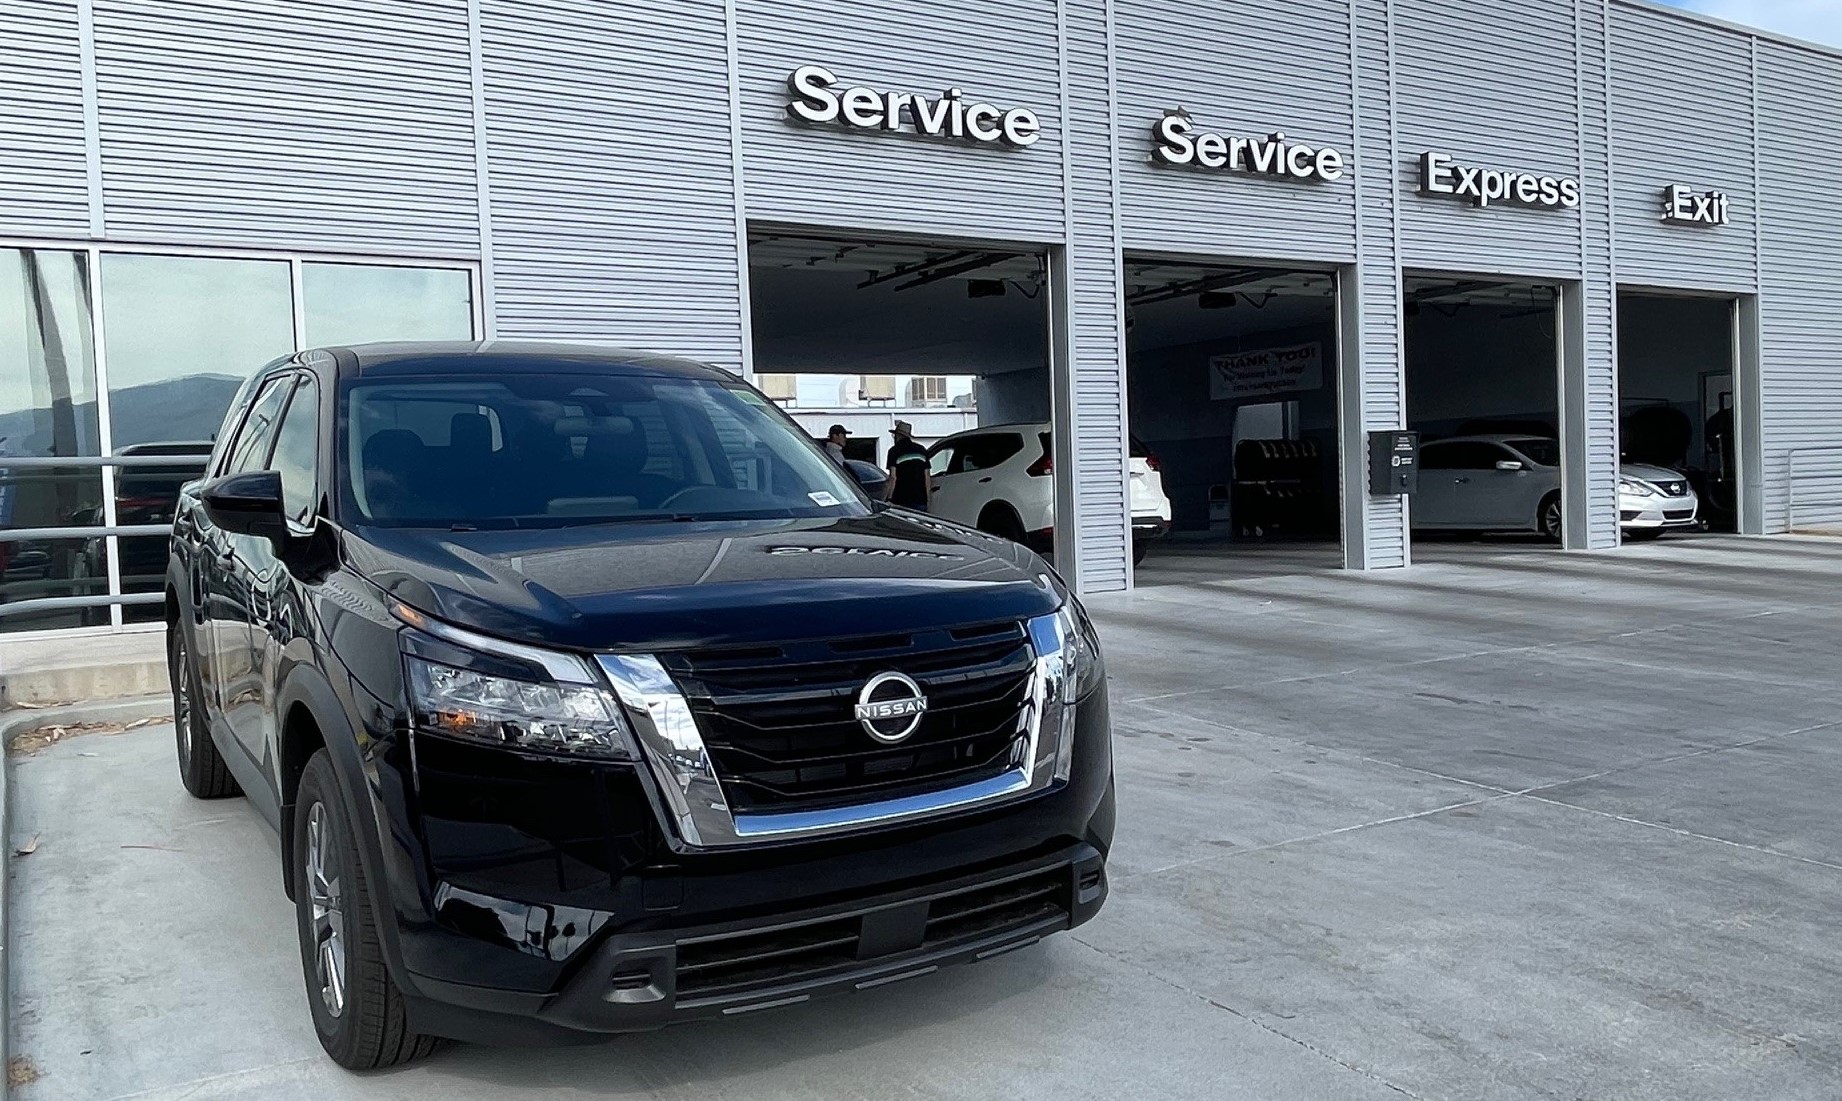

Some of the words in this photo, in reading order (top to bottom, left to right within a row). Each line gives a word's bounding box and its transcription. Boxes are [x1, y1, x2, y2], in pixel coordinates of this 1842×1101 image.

[788, 64, 1041, 146] Service
[1156, 115, 1344, 181] Service
[1426, 151, 1580, 207] Express
[1672, 184, 1730, 225] Exit
[1214, 353, 1269, 370] THANK
[857, 699, 927, 718] NISSAN
